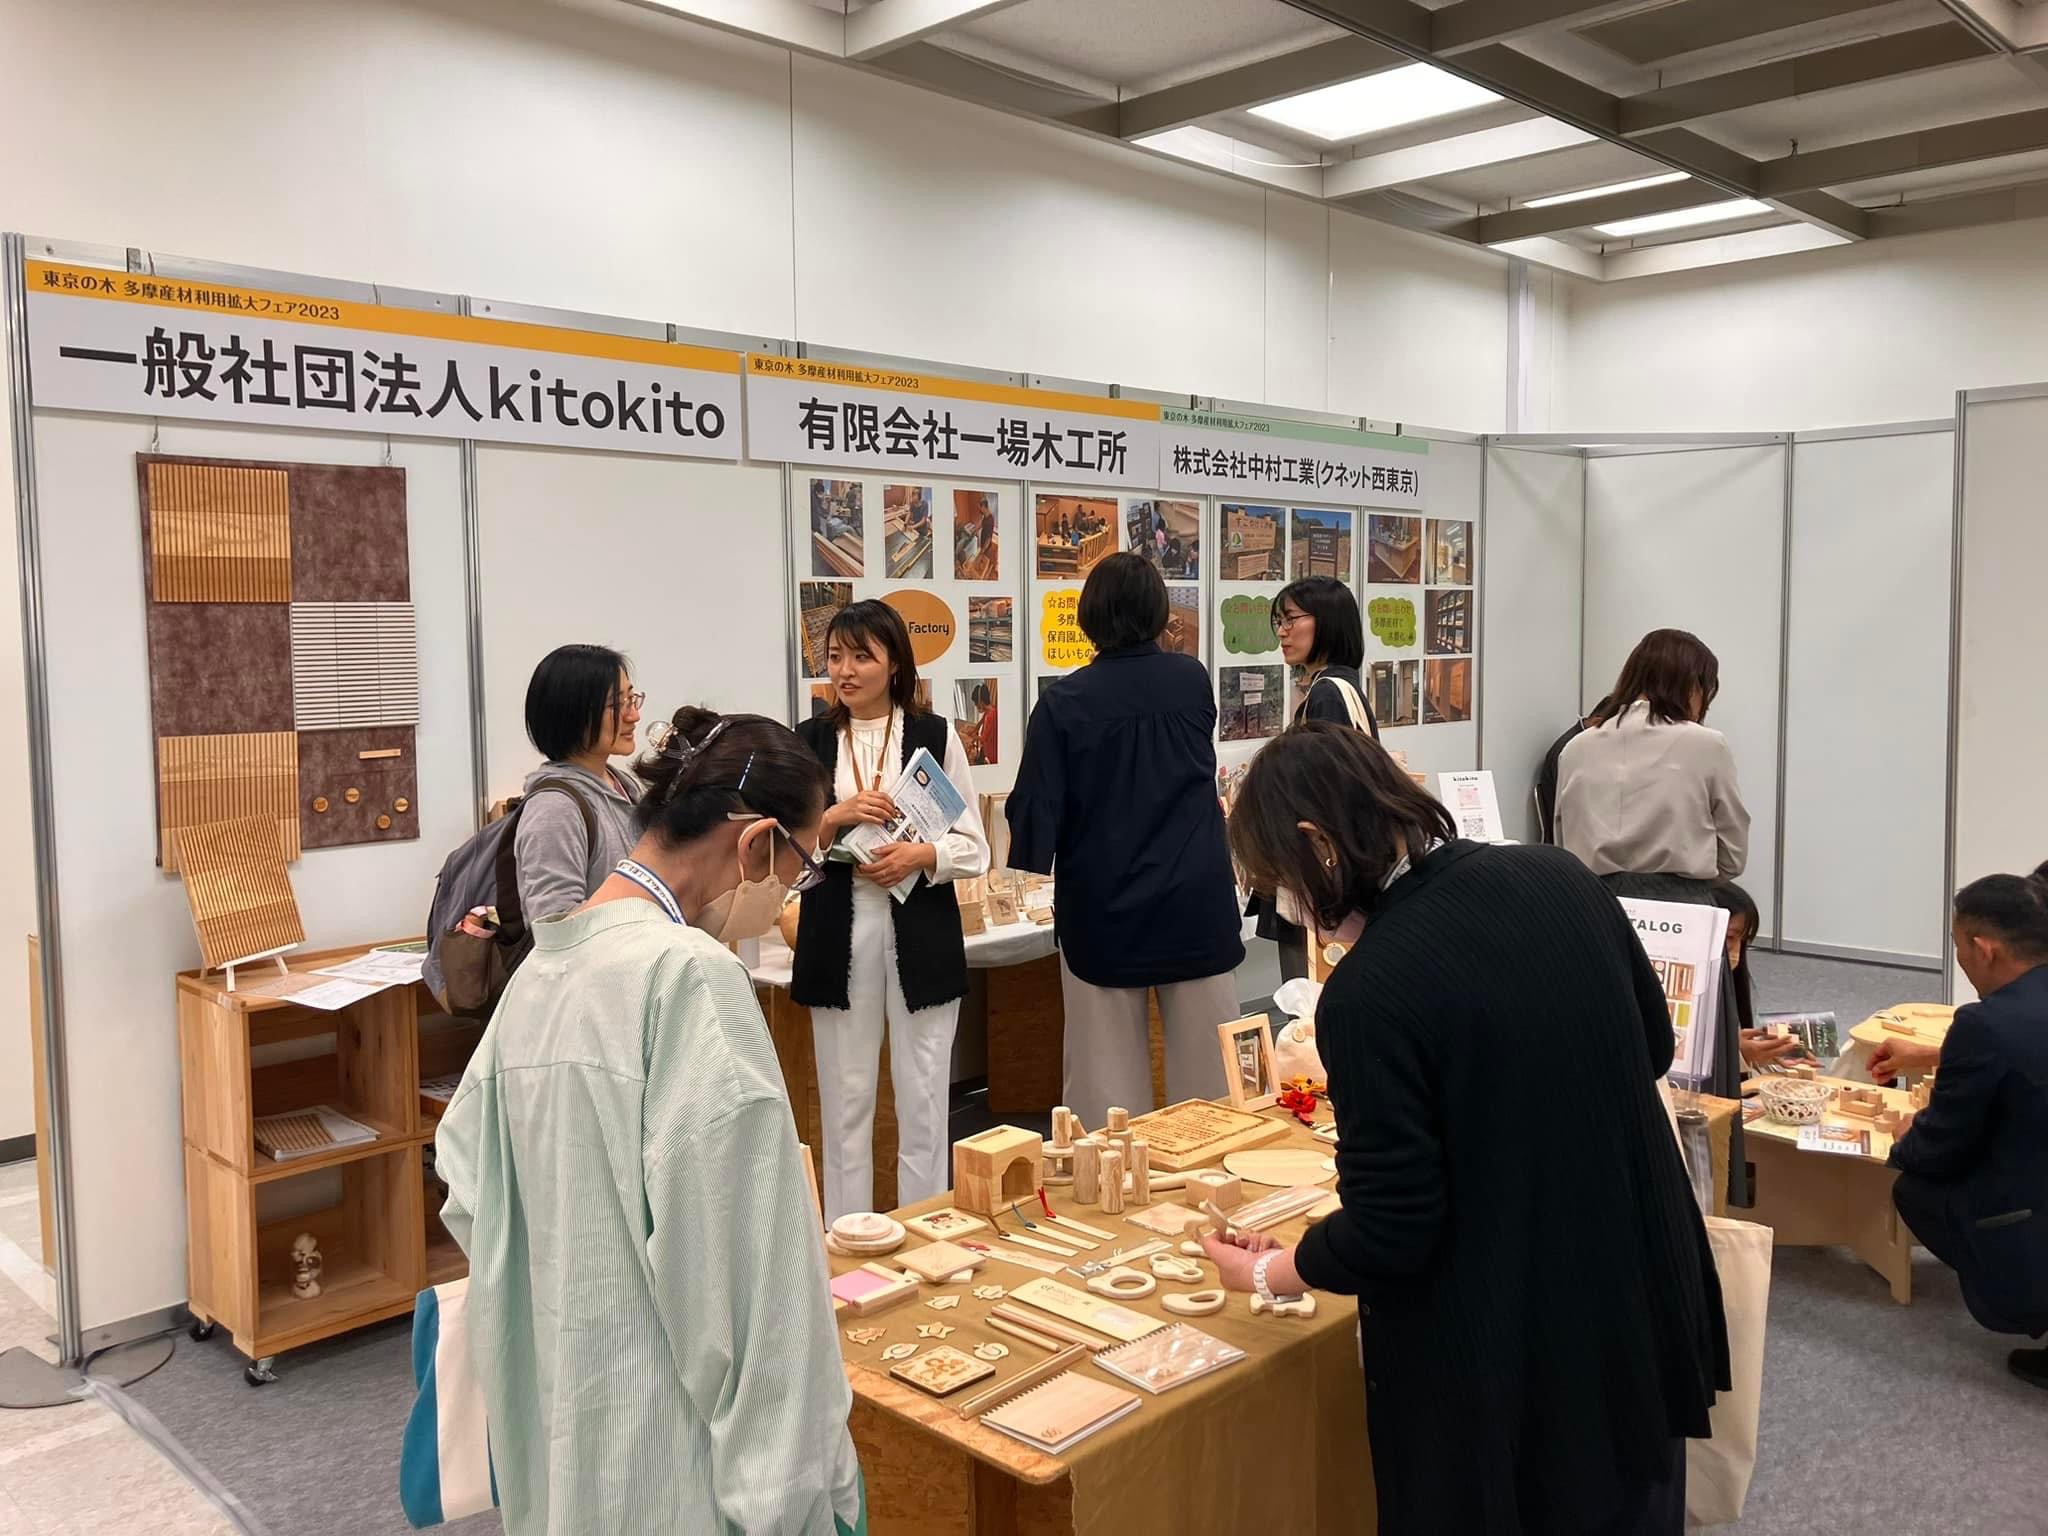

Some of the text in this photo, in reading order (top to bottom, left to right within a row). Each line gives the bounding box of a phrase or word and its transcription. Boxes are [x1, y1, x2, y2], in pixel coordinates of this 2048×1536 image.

[42, 270, 340, 321] 東京の木 多摩産材利用拡大フェア2023
[59, 327, 726, 439] 一般社団法人kitokito
[754, 358, 919, 389] 東京の木 多摩産材利用拡大フェア2023
[799, 397, 1127, 474] 有限会社一場木工所
[1173, 445, 1418, 496] 株式会社中村工業(クネット西東京)
[908, 622, 950, 636] Factory
[1057, 613, 1081, 626] 多摩
